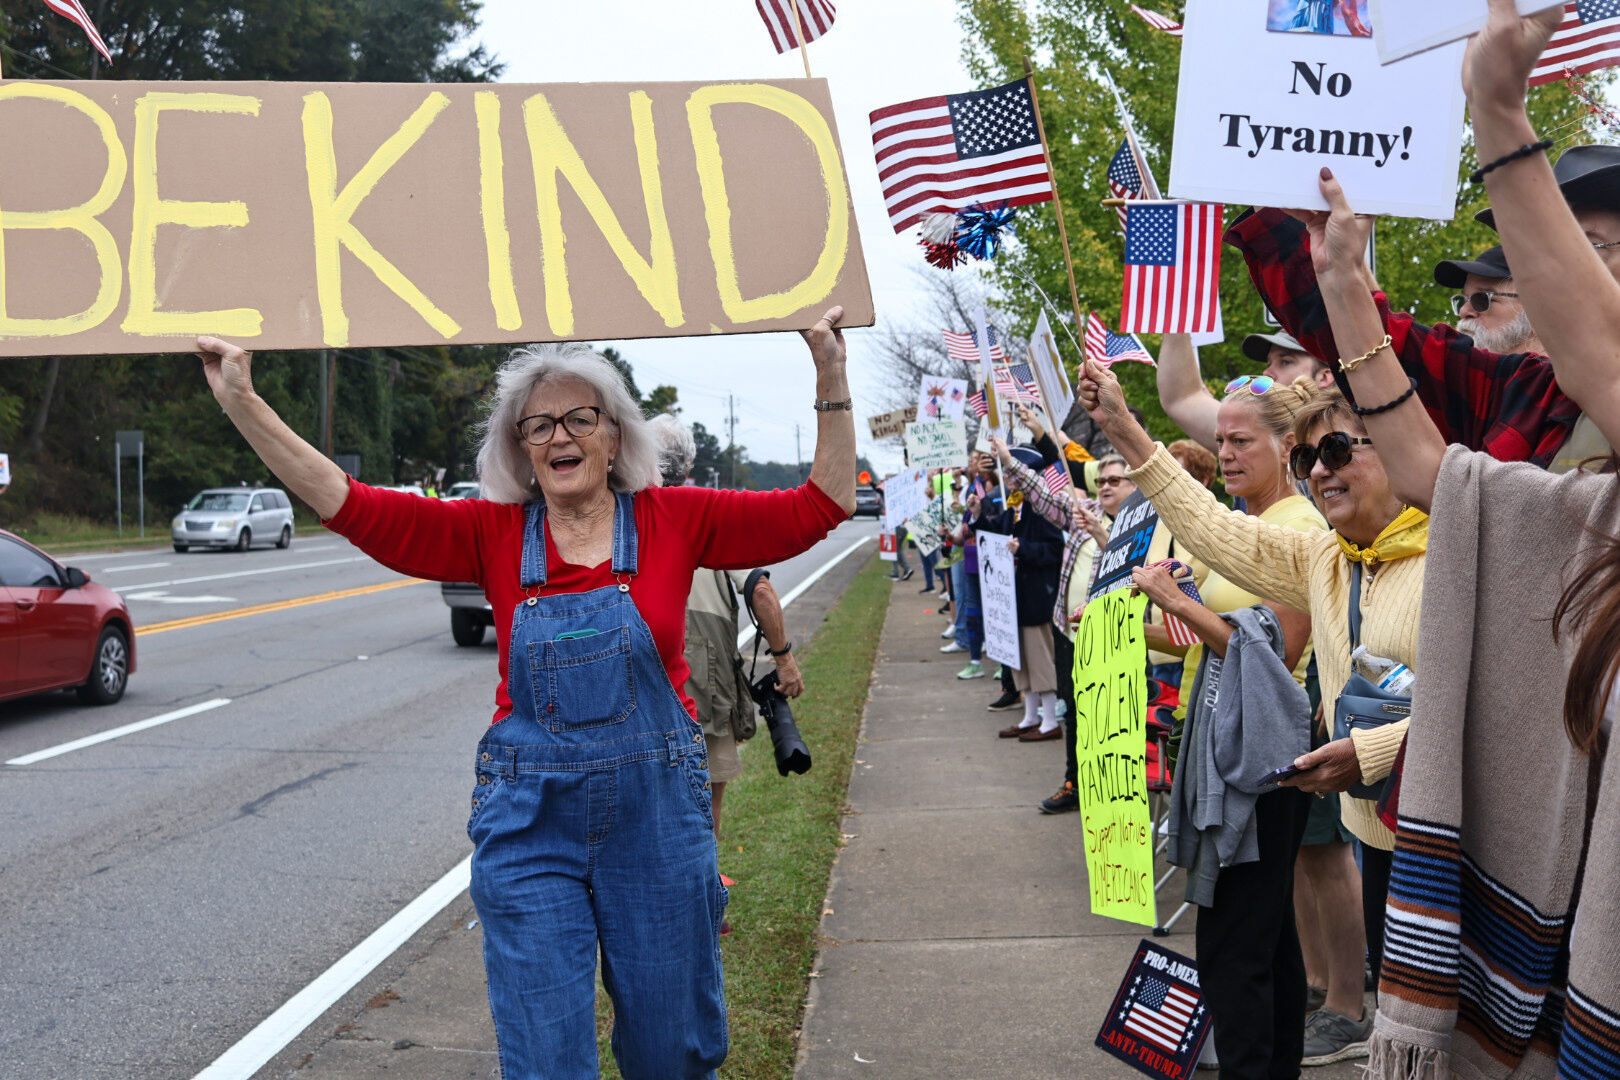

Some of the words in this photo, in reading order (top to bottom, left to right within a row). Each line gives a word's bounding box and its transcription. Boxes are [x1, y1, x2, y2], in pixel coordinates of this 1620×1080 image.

[1288, 61, 1352, 97] No
[1219, 113, 1412, 168] Tyranny!
[0, 82, 264, 340] BE
[302, 83, 849, 348] KIND
[874, 413, 892, 424] NO
[1075, 614, 1094, 684] NO
[1103, 592, 1140, 664] MORE
[1077, 668, 1139, 750] STOLEN
[1080, 752, 1147, 810] FAMILIES
[1085, 811, 1117, 862] Support
[1118, 811, 1147, 848] Native
[1094, 860, 1148, 908] AMERICANS
[1106, 1029, 1183, 1079] ANTI-TRUMP
